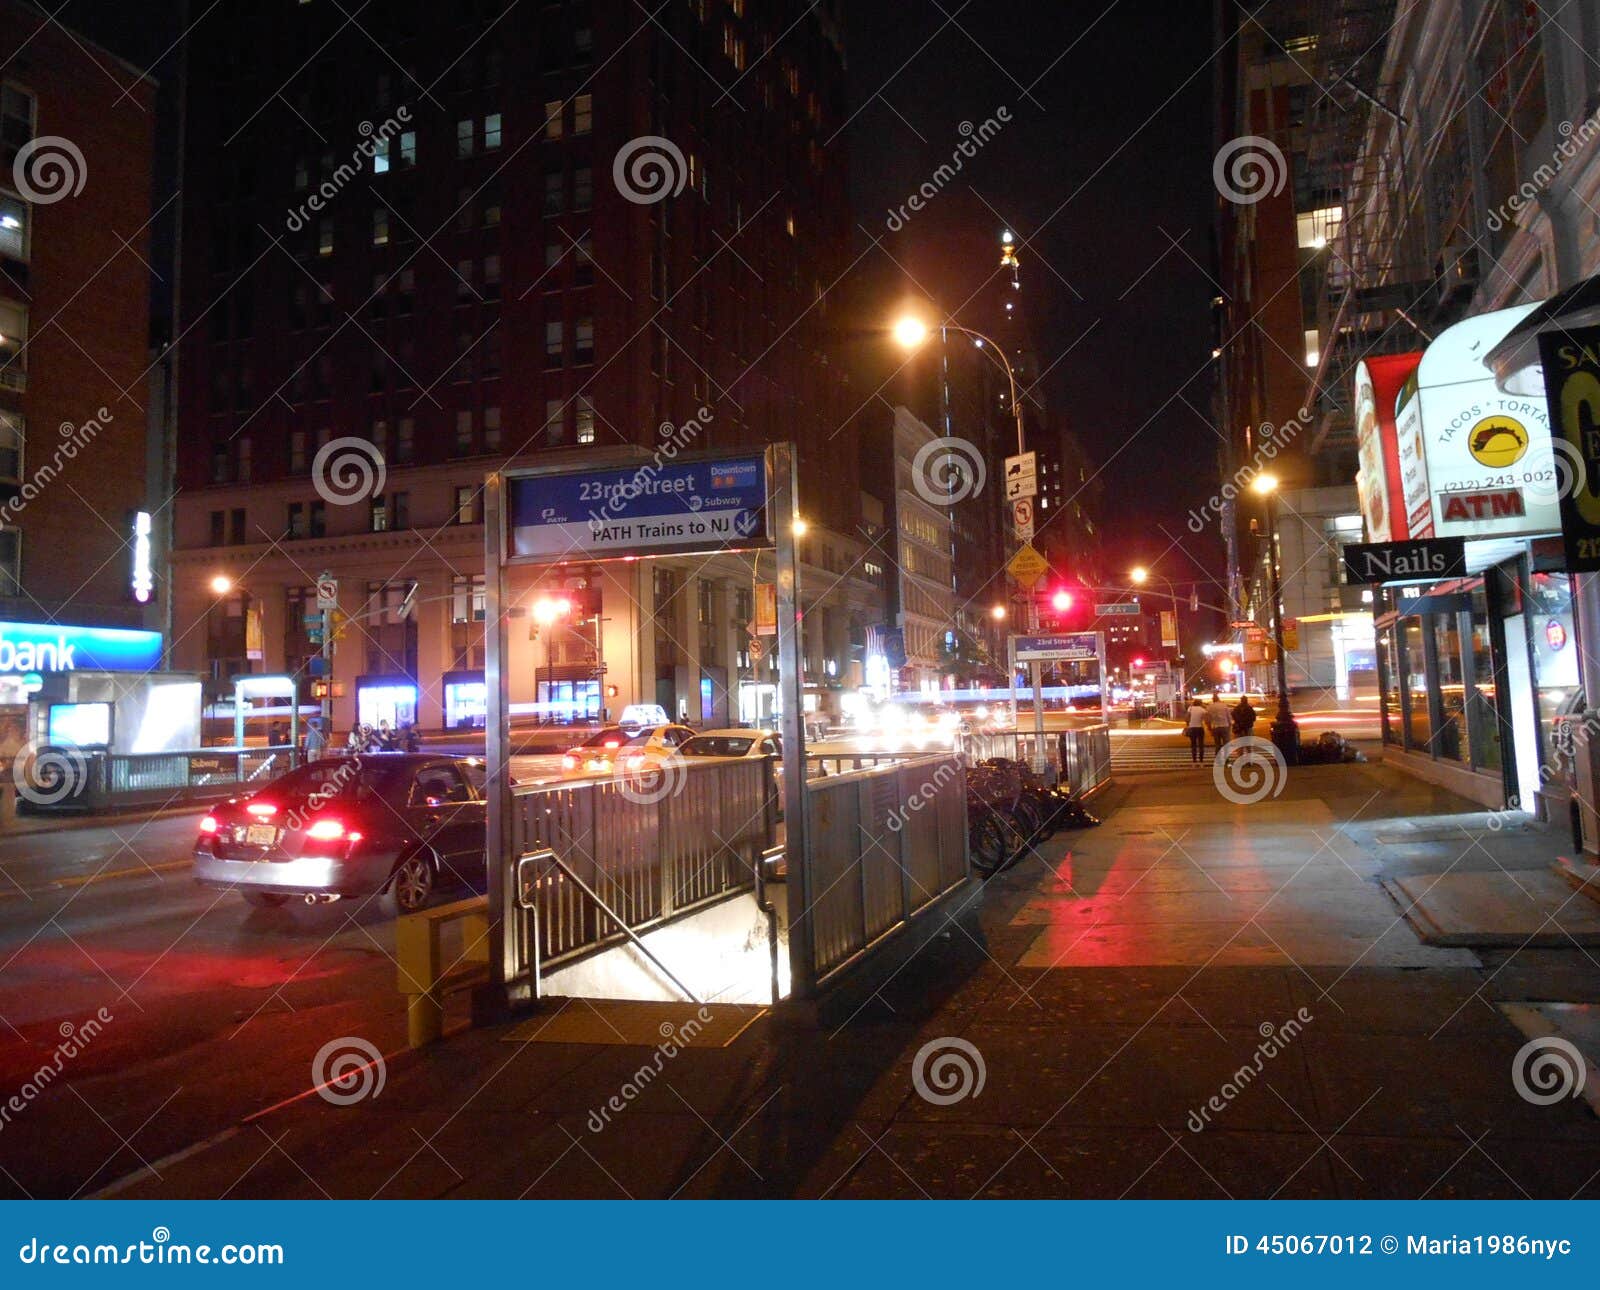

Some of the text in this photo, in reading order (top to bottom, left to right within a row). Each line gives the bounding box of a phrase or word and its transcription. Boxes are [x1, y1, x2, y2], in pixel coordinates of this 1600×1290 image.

[1558, 343, 1600, 369] SA
[1439, 405, 1481, 443] TACOS
[711, 465, 756, 476] Downtown
[1485, 470, 1553, 488] 243-002
[579, 478, 624, 501] 23rd
[631, 474, 695, 497] Street
[704, 496, 742, 507] Subway
[1443, 489, 1521, 520] ATM
[593, 518, 730, 542] PATH Trains to NJ
[1362, 547, 1446, 576] Nails
[0, 633, 75, 672] bank
